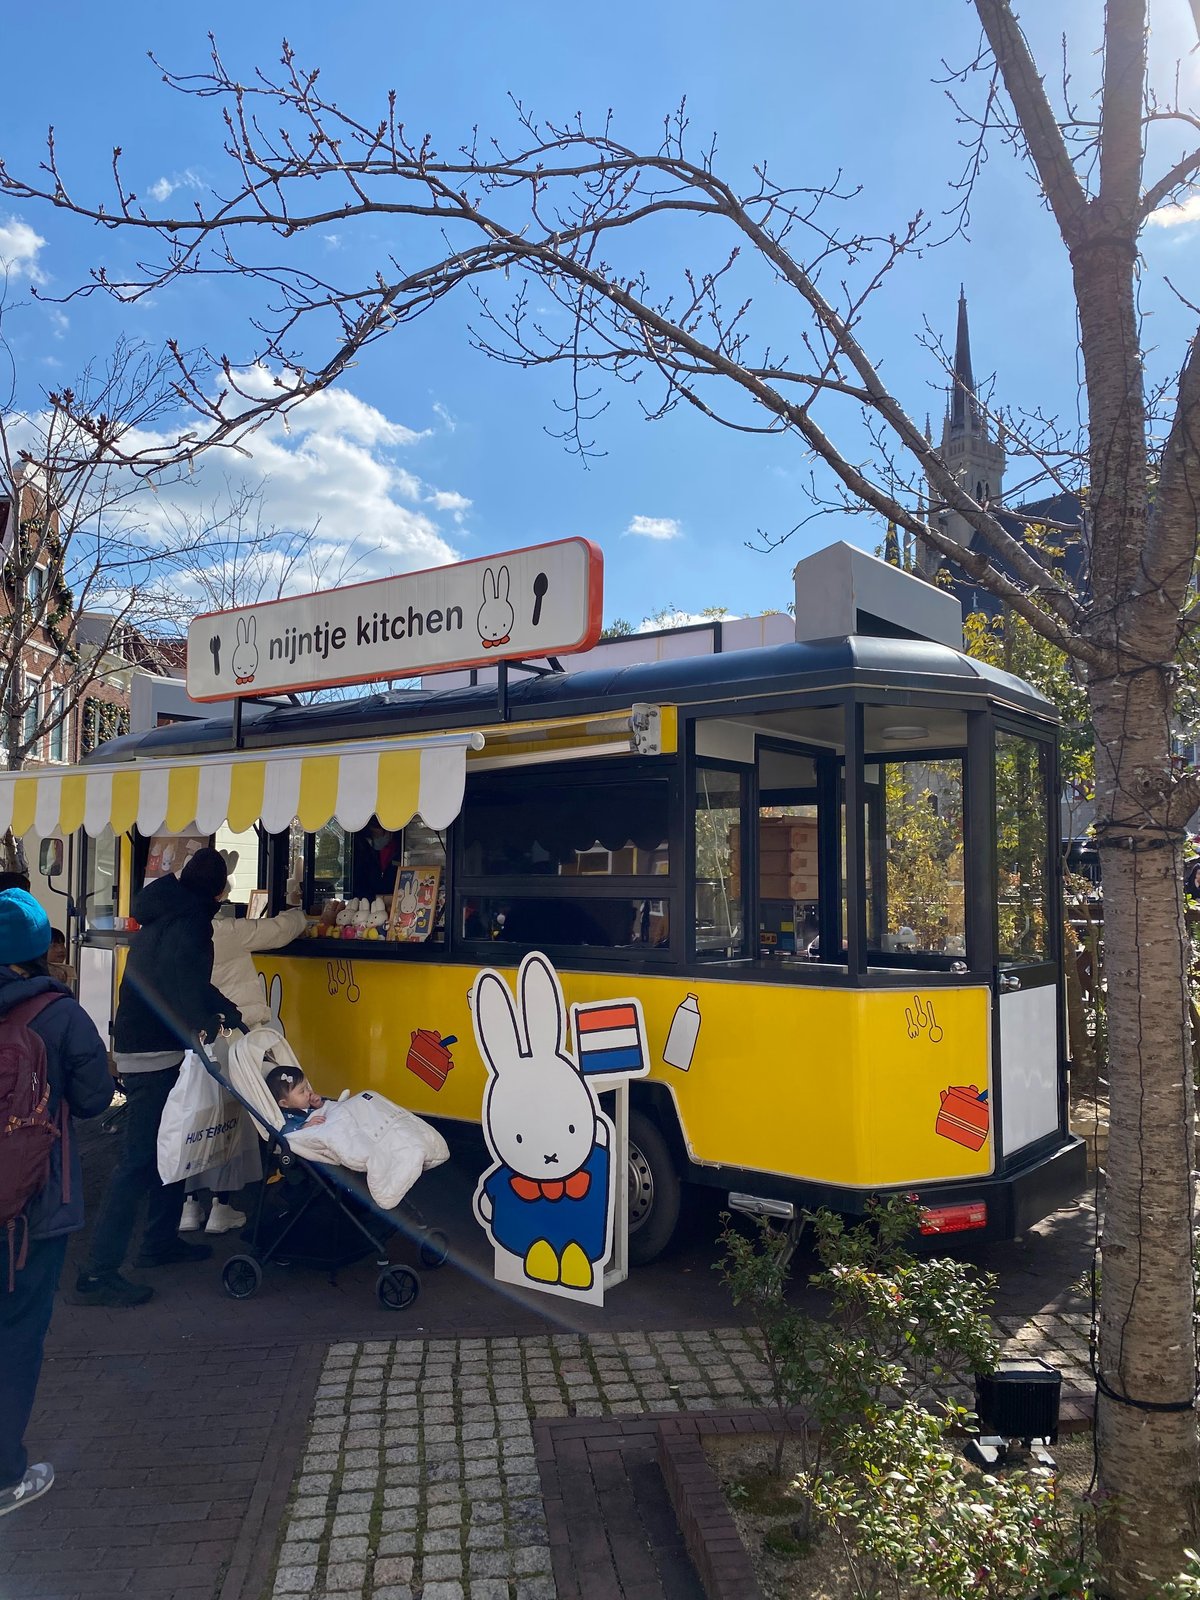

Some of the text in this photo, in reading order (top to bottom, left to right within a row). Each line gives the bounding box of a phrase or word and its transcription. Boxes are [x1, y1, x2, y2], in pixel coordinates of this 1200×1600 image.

[269, 606, 463, 664] nijntje kitchen
[185, 1129, 204, 1145] HUIS
